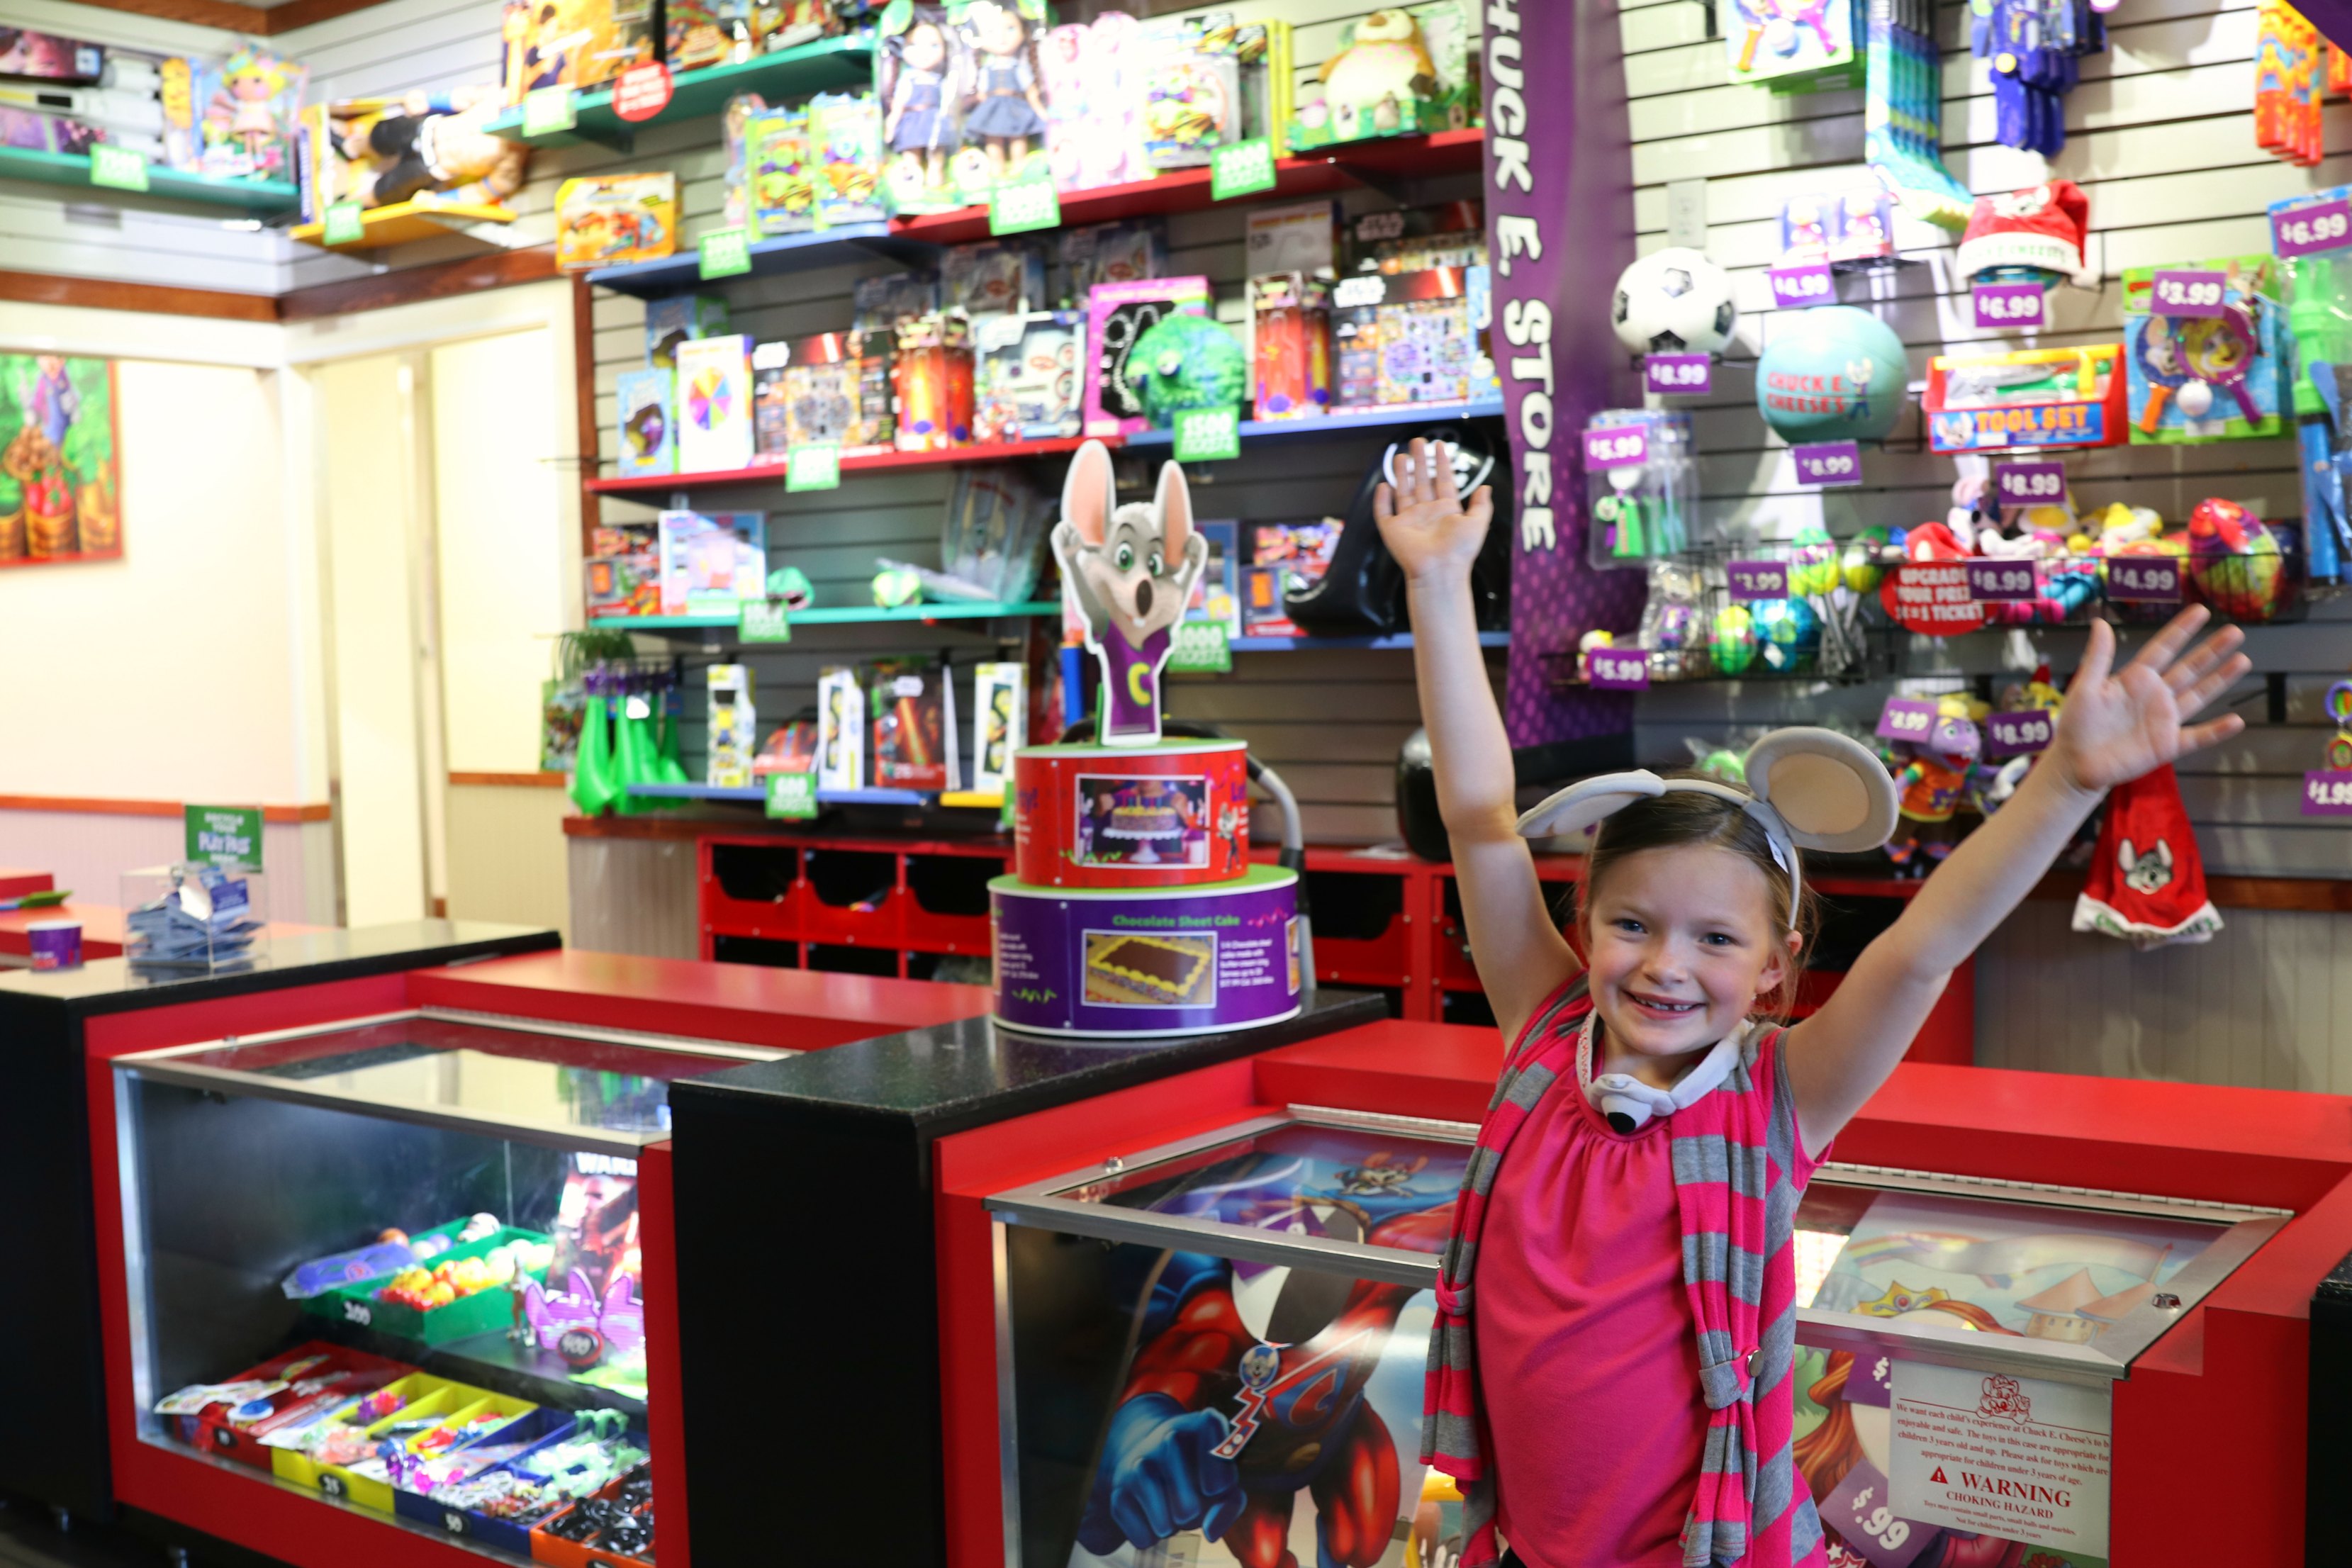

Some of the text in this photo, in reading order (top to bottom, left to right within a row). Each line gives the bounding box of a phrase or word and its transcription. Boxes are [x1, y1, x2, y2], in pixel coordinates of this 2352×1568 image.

[2280, 213, 2348, 245] $6.99
[1496, 215, 1542, 277] E.
[2156, 279, 2222, 306] $3.99
[1978, 294, 2040, 319] $6.99
[1650, 362, 1707, 385] $8.99
[1768, 371, 1825, 391] CHUCK
[1503, 298, 1556, 553] STORE
[1977, 404, 2088, 433] TOOL SET
[1589, 435, 1644, 461] $5.99
[1801, 455, 1854, 476] $8.99
[2002, 471, 2061, 496] $8.99
[1973, 569, 2032, 591] $8.99
[2113, 565, 2175, 590] $4.99
[1594, 656, 1645, 681] $5.99
[1127, 661, 1152, 707] C
[1993, 720, 2050, 746] $8.99
[1112, 914, 1240, 926] Chocolate Sheet Cake
[1896, 1403, 1908, 1412] We
[1947, 1413, 1971, 1423] child's
[1972, 1418, 2011, 1432] experience
[2022, 1426, 2047, 1438] Chuck
[2049, 1430, 2057, 1439] E.
[2059, 1433, 2093, 1445] Cheese's
[1898, 1418, 1930, 1430] enjoyable
[1947, 1426, 1964, 1436] safe.
[1967, 1429, 1981, 1438] The
[1982, 1433, 1997, 1443] toys
[2007, 1437, 2020, 1445] this
[2053, 1446, 2098, 1460] appropriate
[2098, 1453, 2110, 1462] for
[1898, 1430, 1927, 1443] children
[1930, 1435, 1934, 1444] 3
[1935, 1439, 1954, 1448] years
[1956, 1441, 1968, 1450] old
[1969, 1444, 1983, 1452] and
[1985, 1448, 1997, 1457] up.
[2001, 1449, 2025, 1460] Please
[2026, 1455, 2039, 1463] ask
[2040, 1456, 2052, 1465] for
[2054, 1460, 2069, 1470] toys
[2071, 1462, 2094, 1474] which
[1921, 1450, 1963, 1463] appropriate
[1964, 1455, 1975, 1465] for
[1976, 1458, 2005, 1470] children
[2007, 1465, 2029, 1475] under
[2030, 1468, 2036, 1477] 3
[2037, 1472, 2057, 1482] years
[2068, 1477, 2083, 1486] age.
[1961, 1472, 2071, 1508] WARNING
[1852, 1486, 1910, 1550] $.99
[1924, 1500, 1937, 1509] Toys
[1950, 1506, 1973, 1516] contain
[1973, 1509, 1988, 1518] small
[2007, 1516, 2022, 1525] small
[2023, 1519, 2037, 1528] balls
[2039, 1523, 2050, 1531] and
[1946, 1491, 2054, 1519] CHOKING HAZARD
[1967, 1518, 1976, 1526] for
[1977, 1520, 2001, 1532] children
[2002, 1525, 2020, 1535] under
[2025, 1530, 2042, 1540] years
